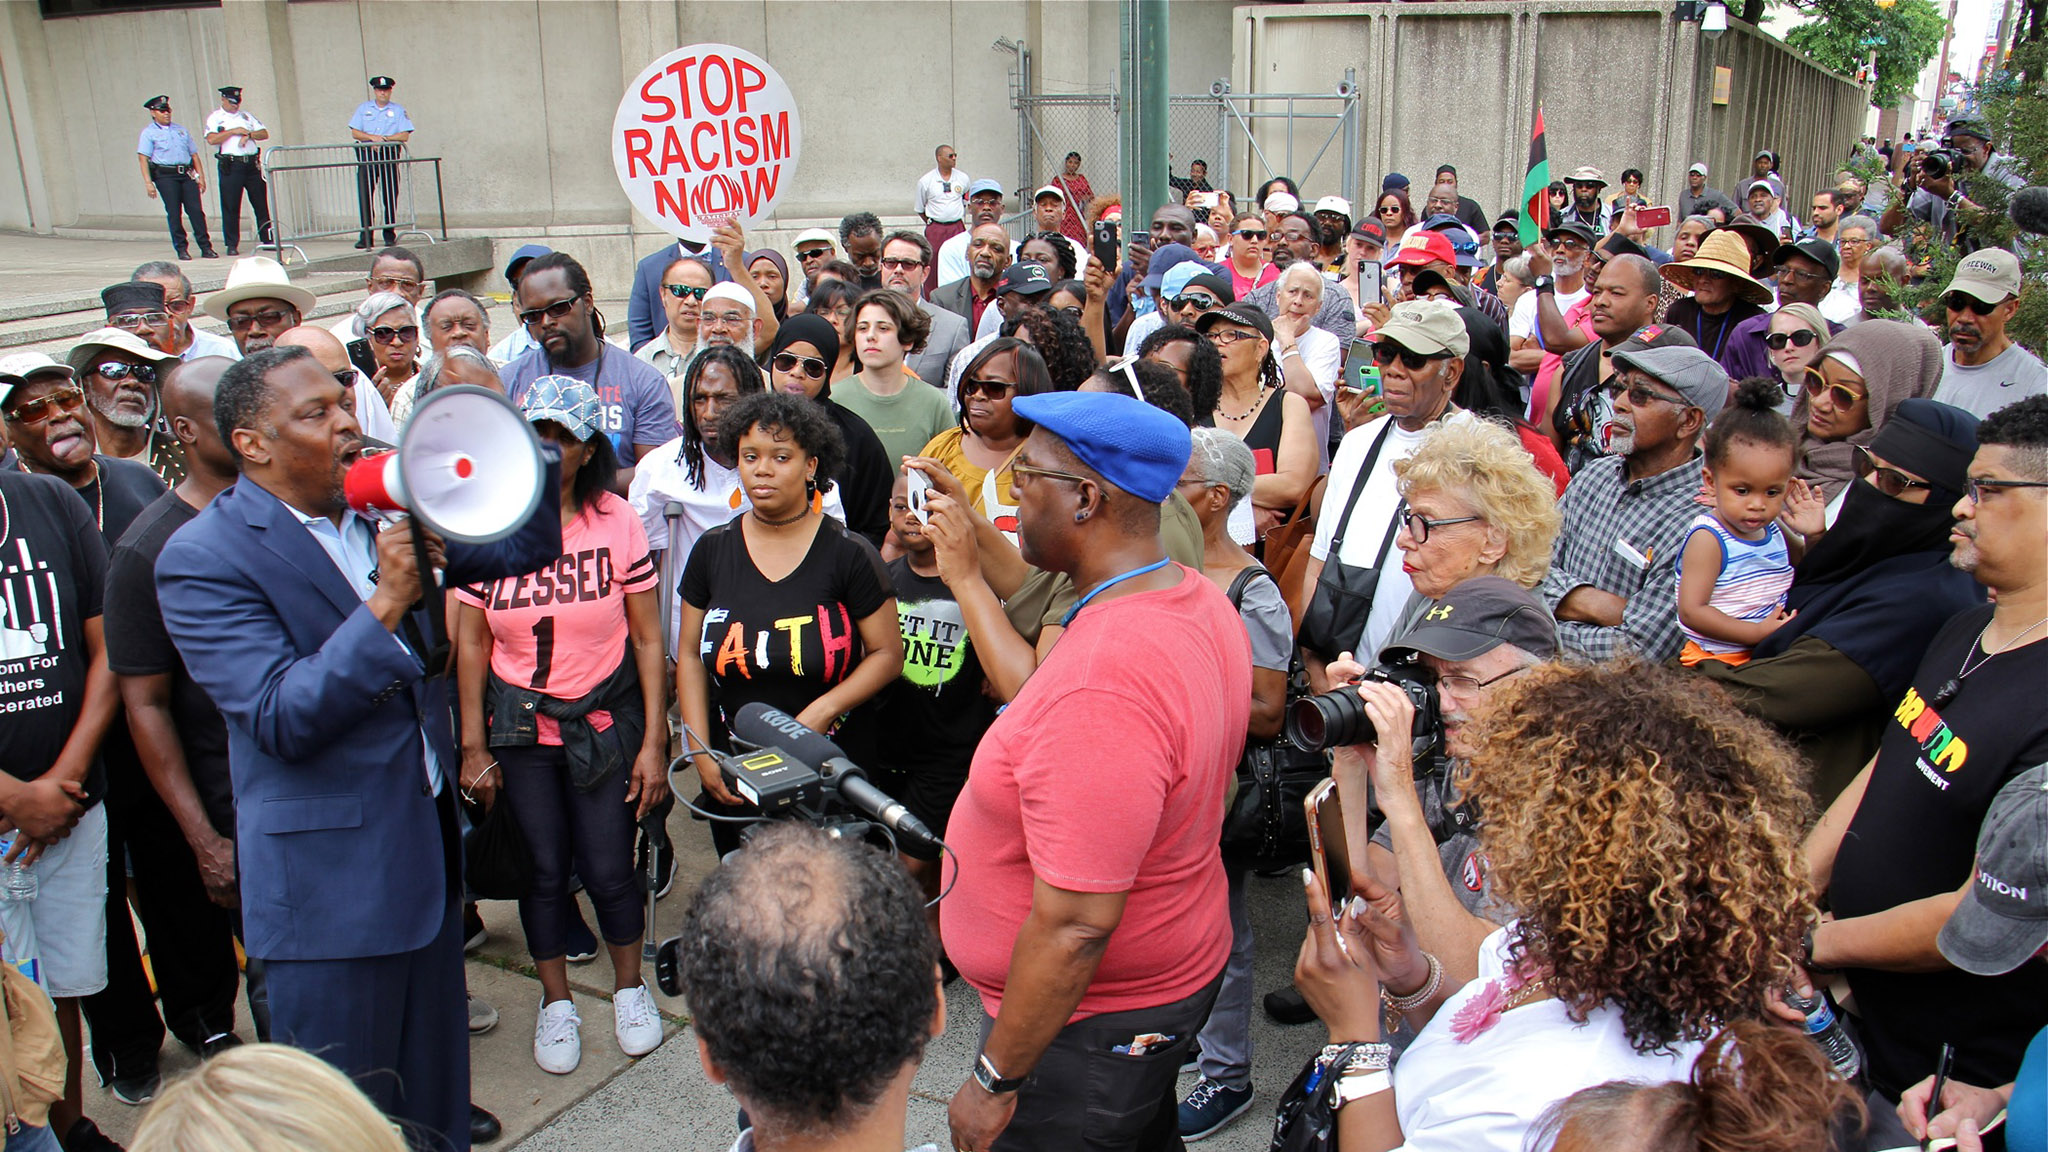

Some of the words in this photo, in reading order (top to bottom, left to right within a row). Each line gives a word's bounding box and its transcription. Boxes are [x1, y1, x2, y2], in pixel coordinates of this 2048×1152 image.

[640, 54, 767, 123] STOP
[623, 111, 791, 179] RACISM
[653, 164, 781, 228] NOW
[1961, 260, 1998, 274] FREEWAY
[29, 656, 59, 670] For
[529, 615, 555, 690] 1
[700, 601, 853, 684] FAITH
[929, 619, 960, 643] IT
[1915, 756, 1951, 791] MOVEMENT
